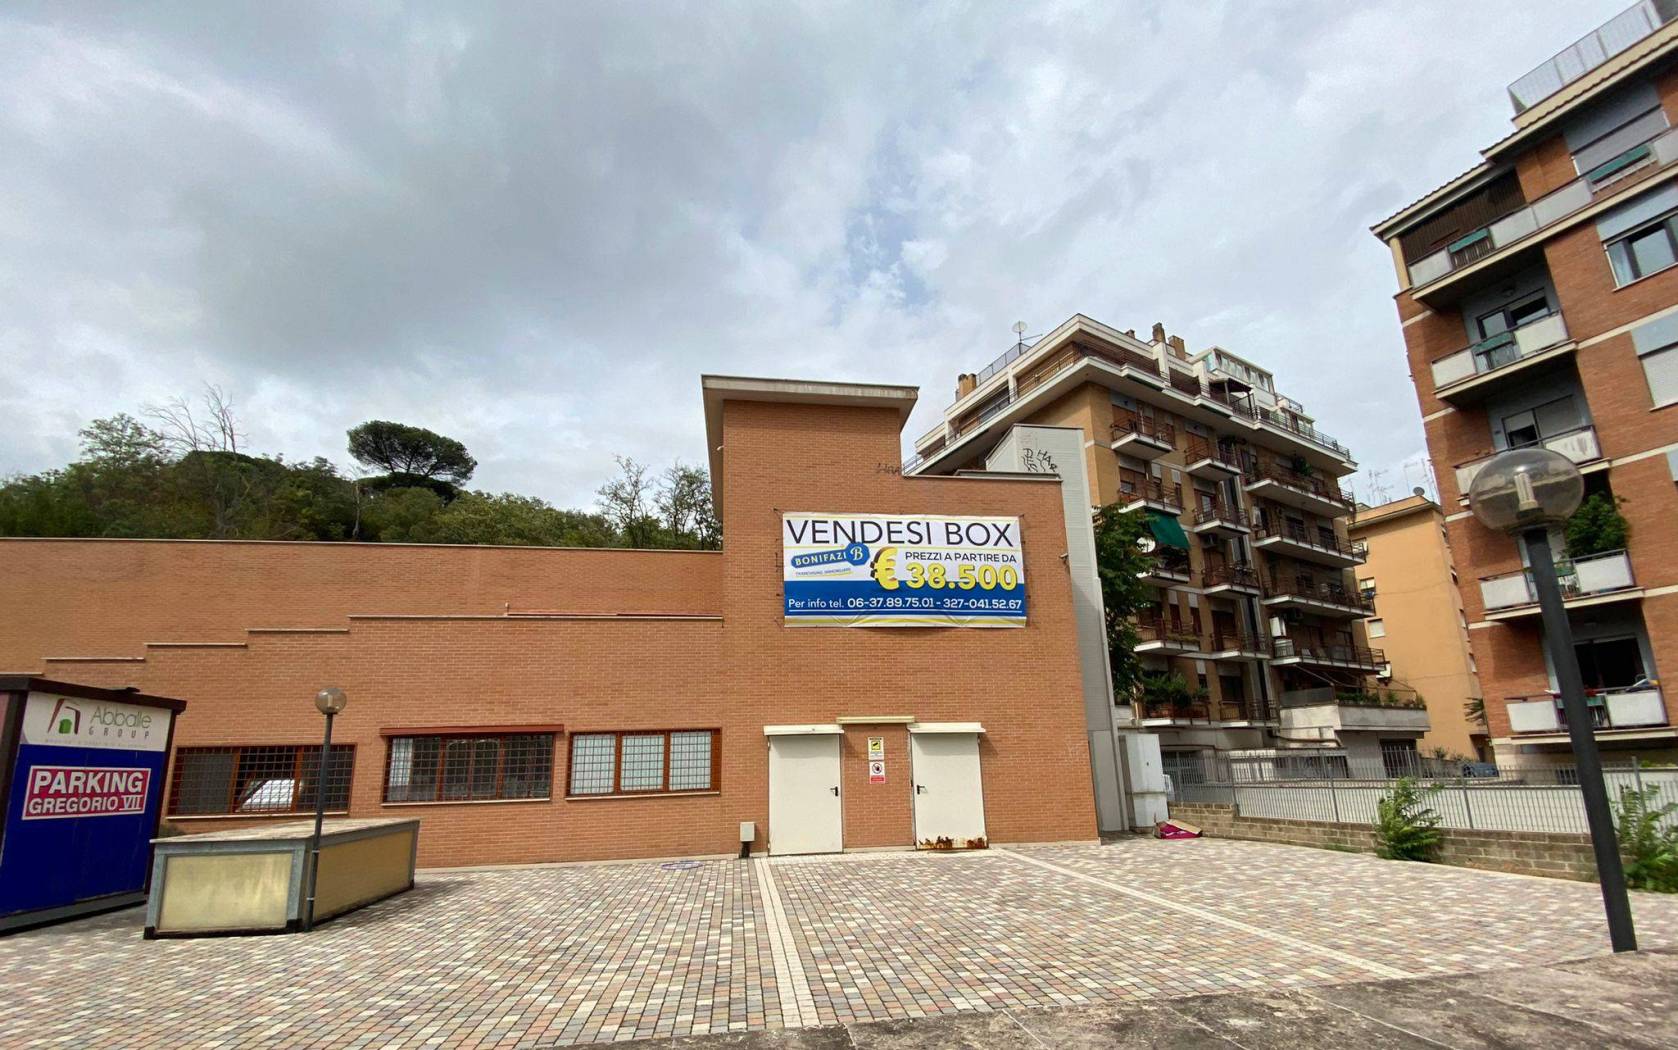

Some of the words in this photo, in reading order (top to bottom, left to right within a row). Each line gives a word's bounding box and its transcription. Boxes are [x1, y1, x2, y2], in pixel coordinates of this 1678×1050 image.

[786, 519, 932, 545] VENDESI
[945, 521, 1014, 547] BOX
[795, 551, 847, 566] BONIFAZI
[850, 546, 864, 561] B
[905, 552, 942, 560] PREZZI
[944, 553, 952, 561] A
[955, 553, 1000, 562] PARTIRE
[1002, 554, 1017, 562] DA
[870, 546, 899, 590] €
[905, 563, 1018, 591] 38.500
[788, 598, 805, 608] Per
[808, 598, 827, 608] info
[829, 598, 845, 608] tel.
[847, 597, 934, 608] 06-37.89.75.01
[943, 598, 1022, 609] 327-041.52.67
[88, 726, 150, 739] GROUP
[33, 770, 144, 795] PARKING
[28, 796, 119, 814] GREGORIO
[119, 794, 144, 811] VII
